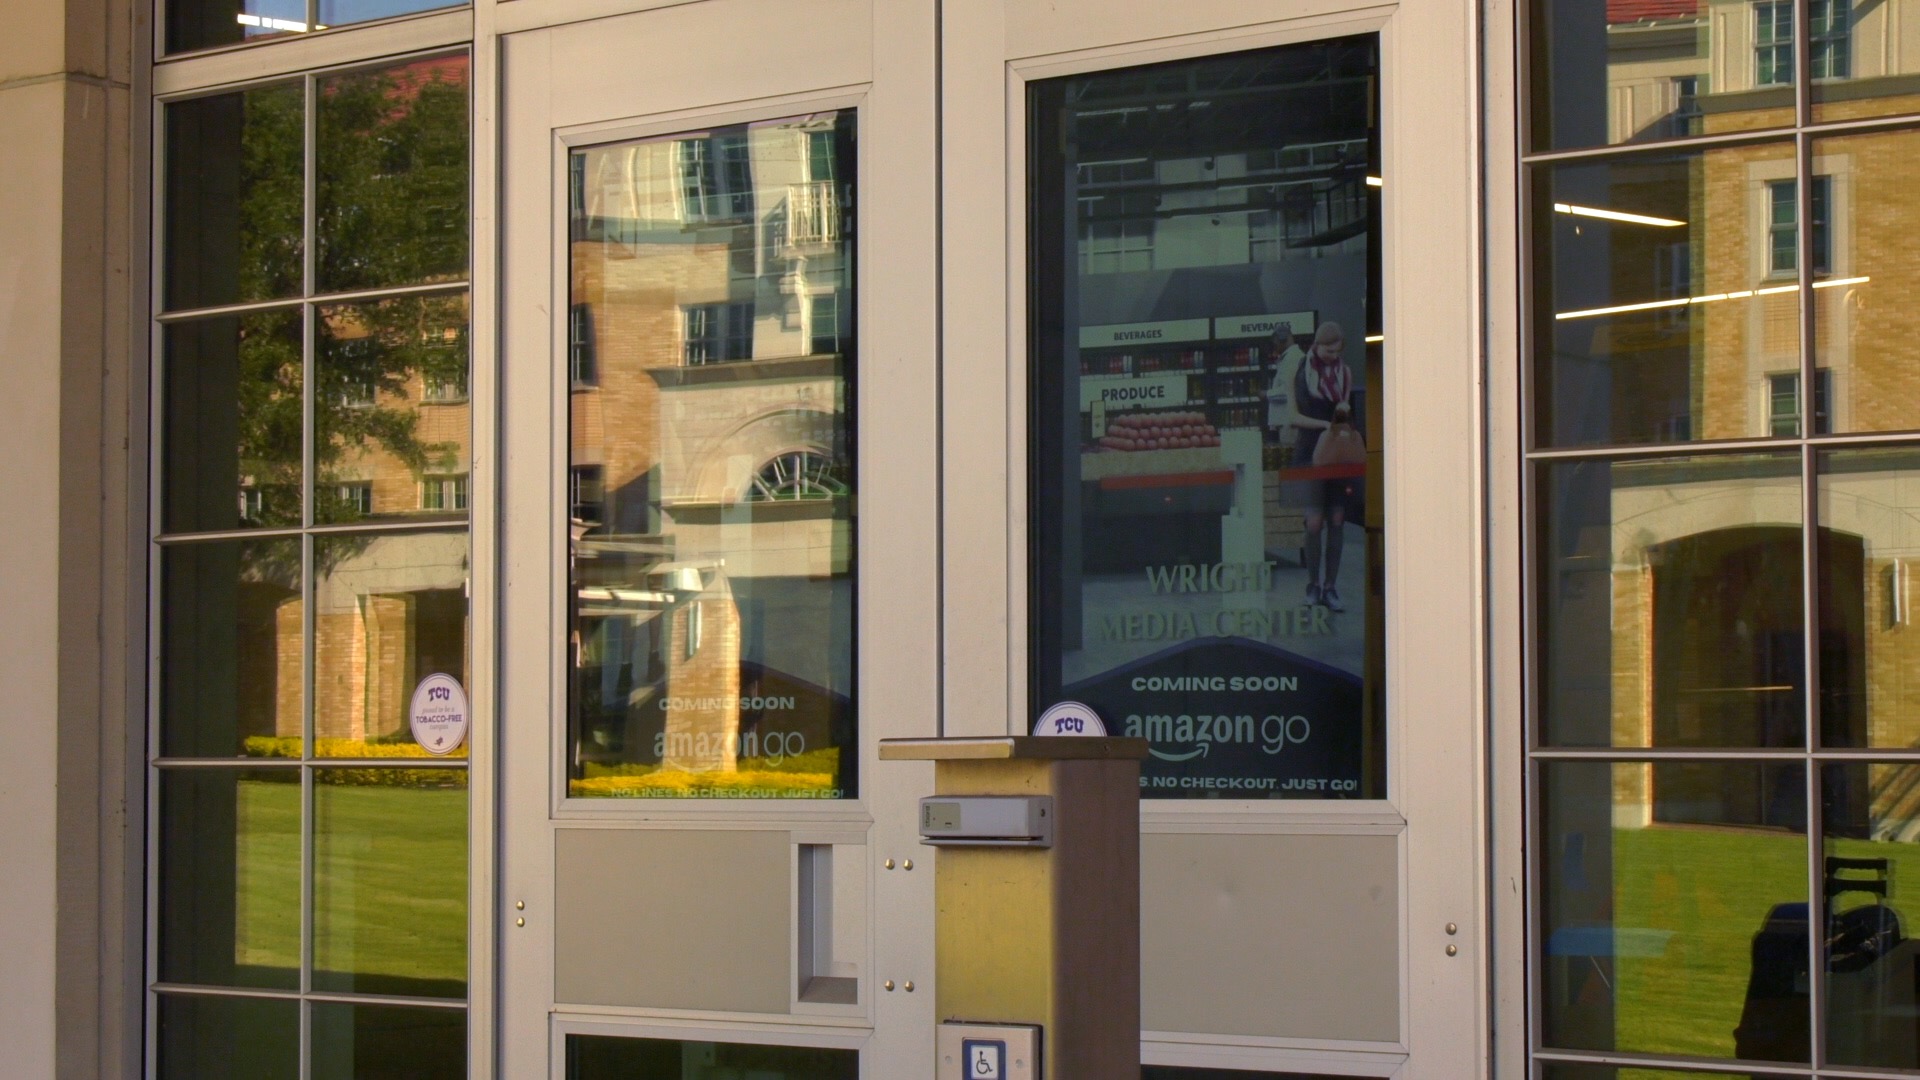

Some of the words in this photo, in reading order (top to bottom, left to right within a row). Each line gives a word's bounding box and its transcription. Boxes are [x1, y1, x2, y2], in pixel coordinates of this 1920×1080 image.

[1113, 329, 1163, 341] BEVERAGES
[1101, 385, 1165, 401] PRODUCE
[1145, 560, 1277, 593] WRIGHT
[1100, 609, 1198, 642] MEDIA
[1209, 604, 1331, 637] CENTER
[1131, 676, 1226, 691] COMING
[1230, 676, 1298, 691] SOON
[428, 686, 450, 702] TCU
[740, 697, 795, 710] SOON
[416, 714, 462, 724] TOBACCO-FREE
[1054, 717, 1084, 733] TCU
[1125, 714, 1255, 743] amazon
[1261, 715, 1310, 754] go
[653, 731, 759, 758] amazon
[763, 732, 805, 767] go
[1153, 777, 1176, 788] NO
[1282, 779, 1328, 790] JUST
[1330, 779, 1358, 791] GO!
[611, 787, 630, 797] NO
[680, 788, 699, 798] NO
[783, 789, 819, 798] JUST
[820, 788, 844, 798] GO!
